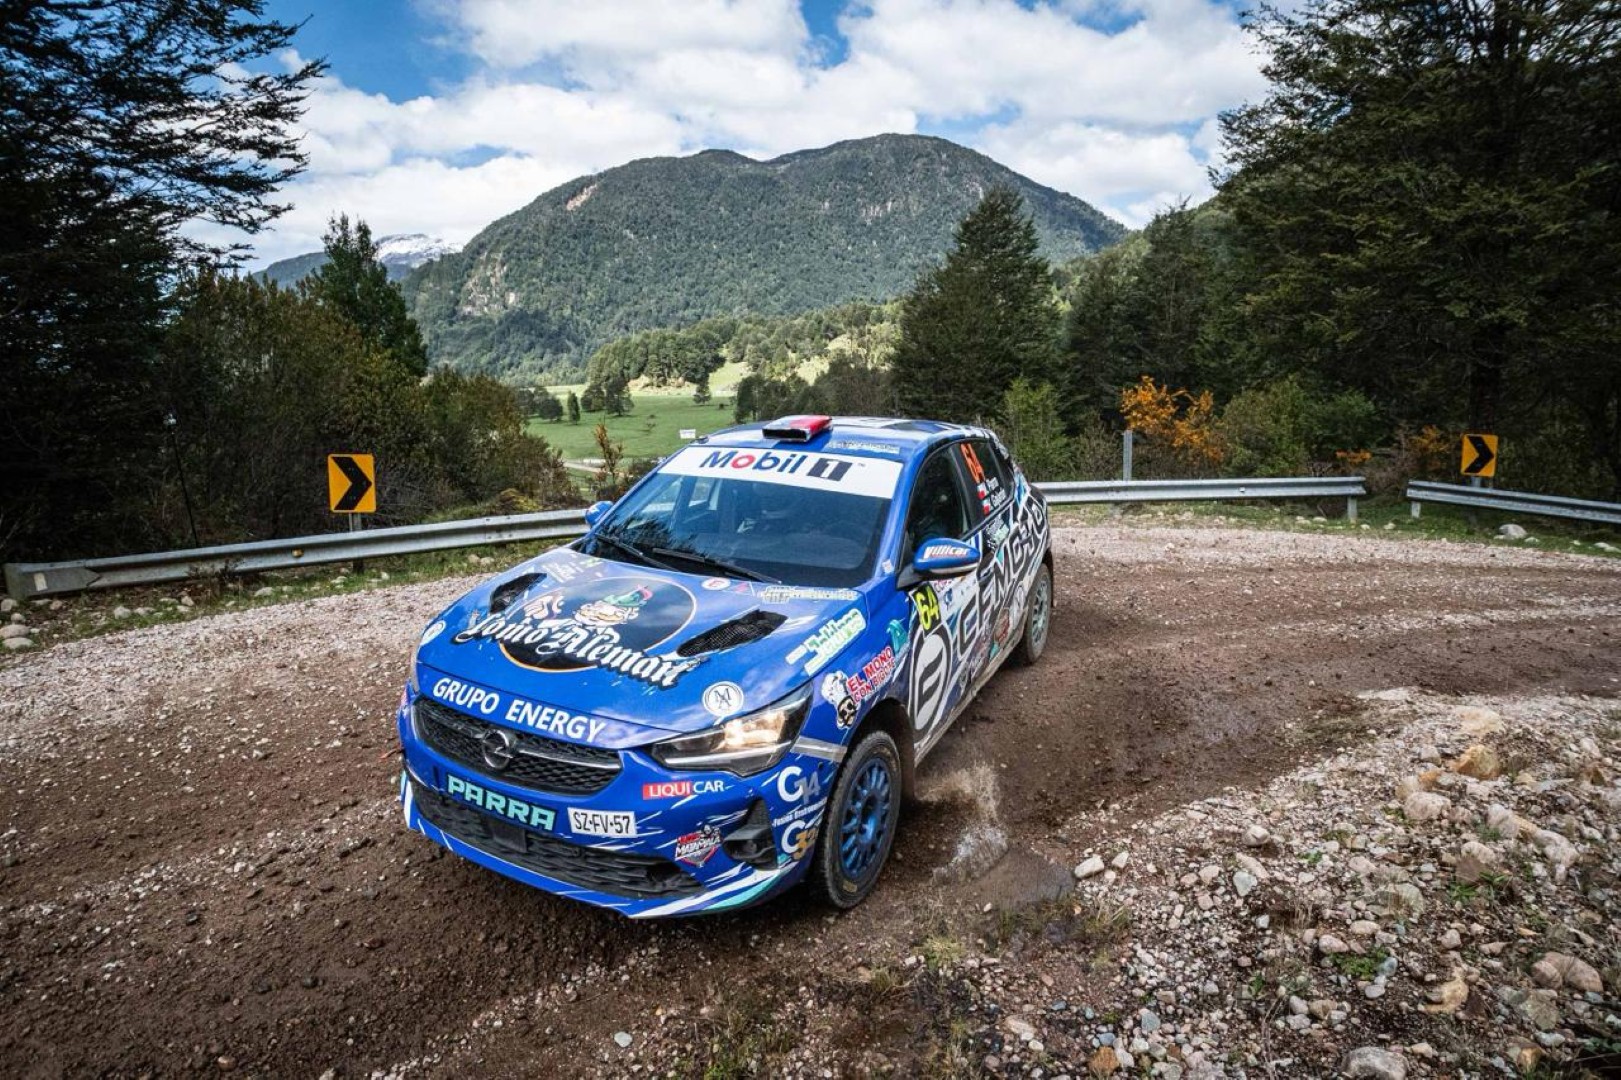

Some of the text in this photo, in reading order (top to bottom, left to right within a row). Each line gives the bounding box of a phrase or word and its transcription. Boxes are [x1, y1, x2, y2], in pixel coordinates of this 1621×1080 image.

[699, 451, 808, 473] Mobil
[916, 586, 939, 630] 64
[847, 647, 892, 692] EL MONO
[433, 677, 606, 743] GRUPO ENERGY
[854, 683, 872, 702] CON
[447, 775, 556, 831] PARRA
[650, 780, 724, 797] LIQUI CAR
